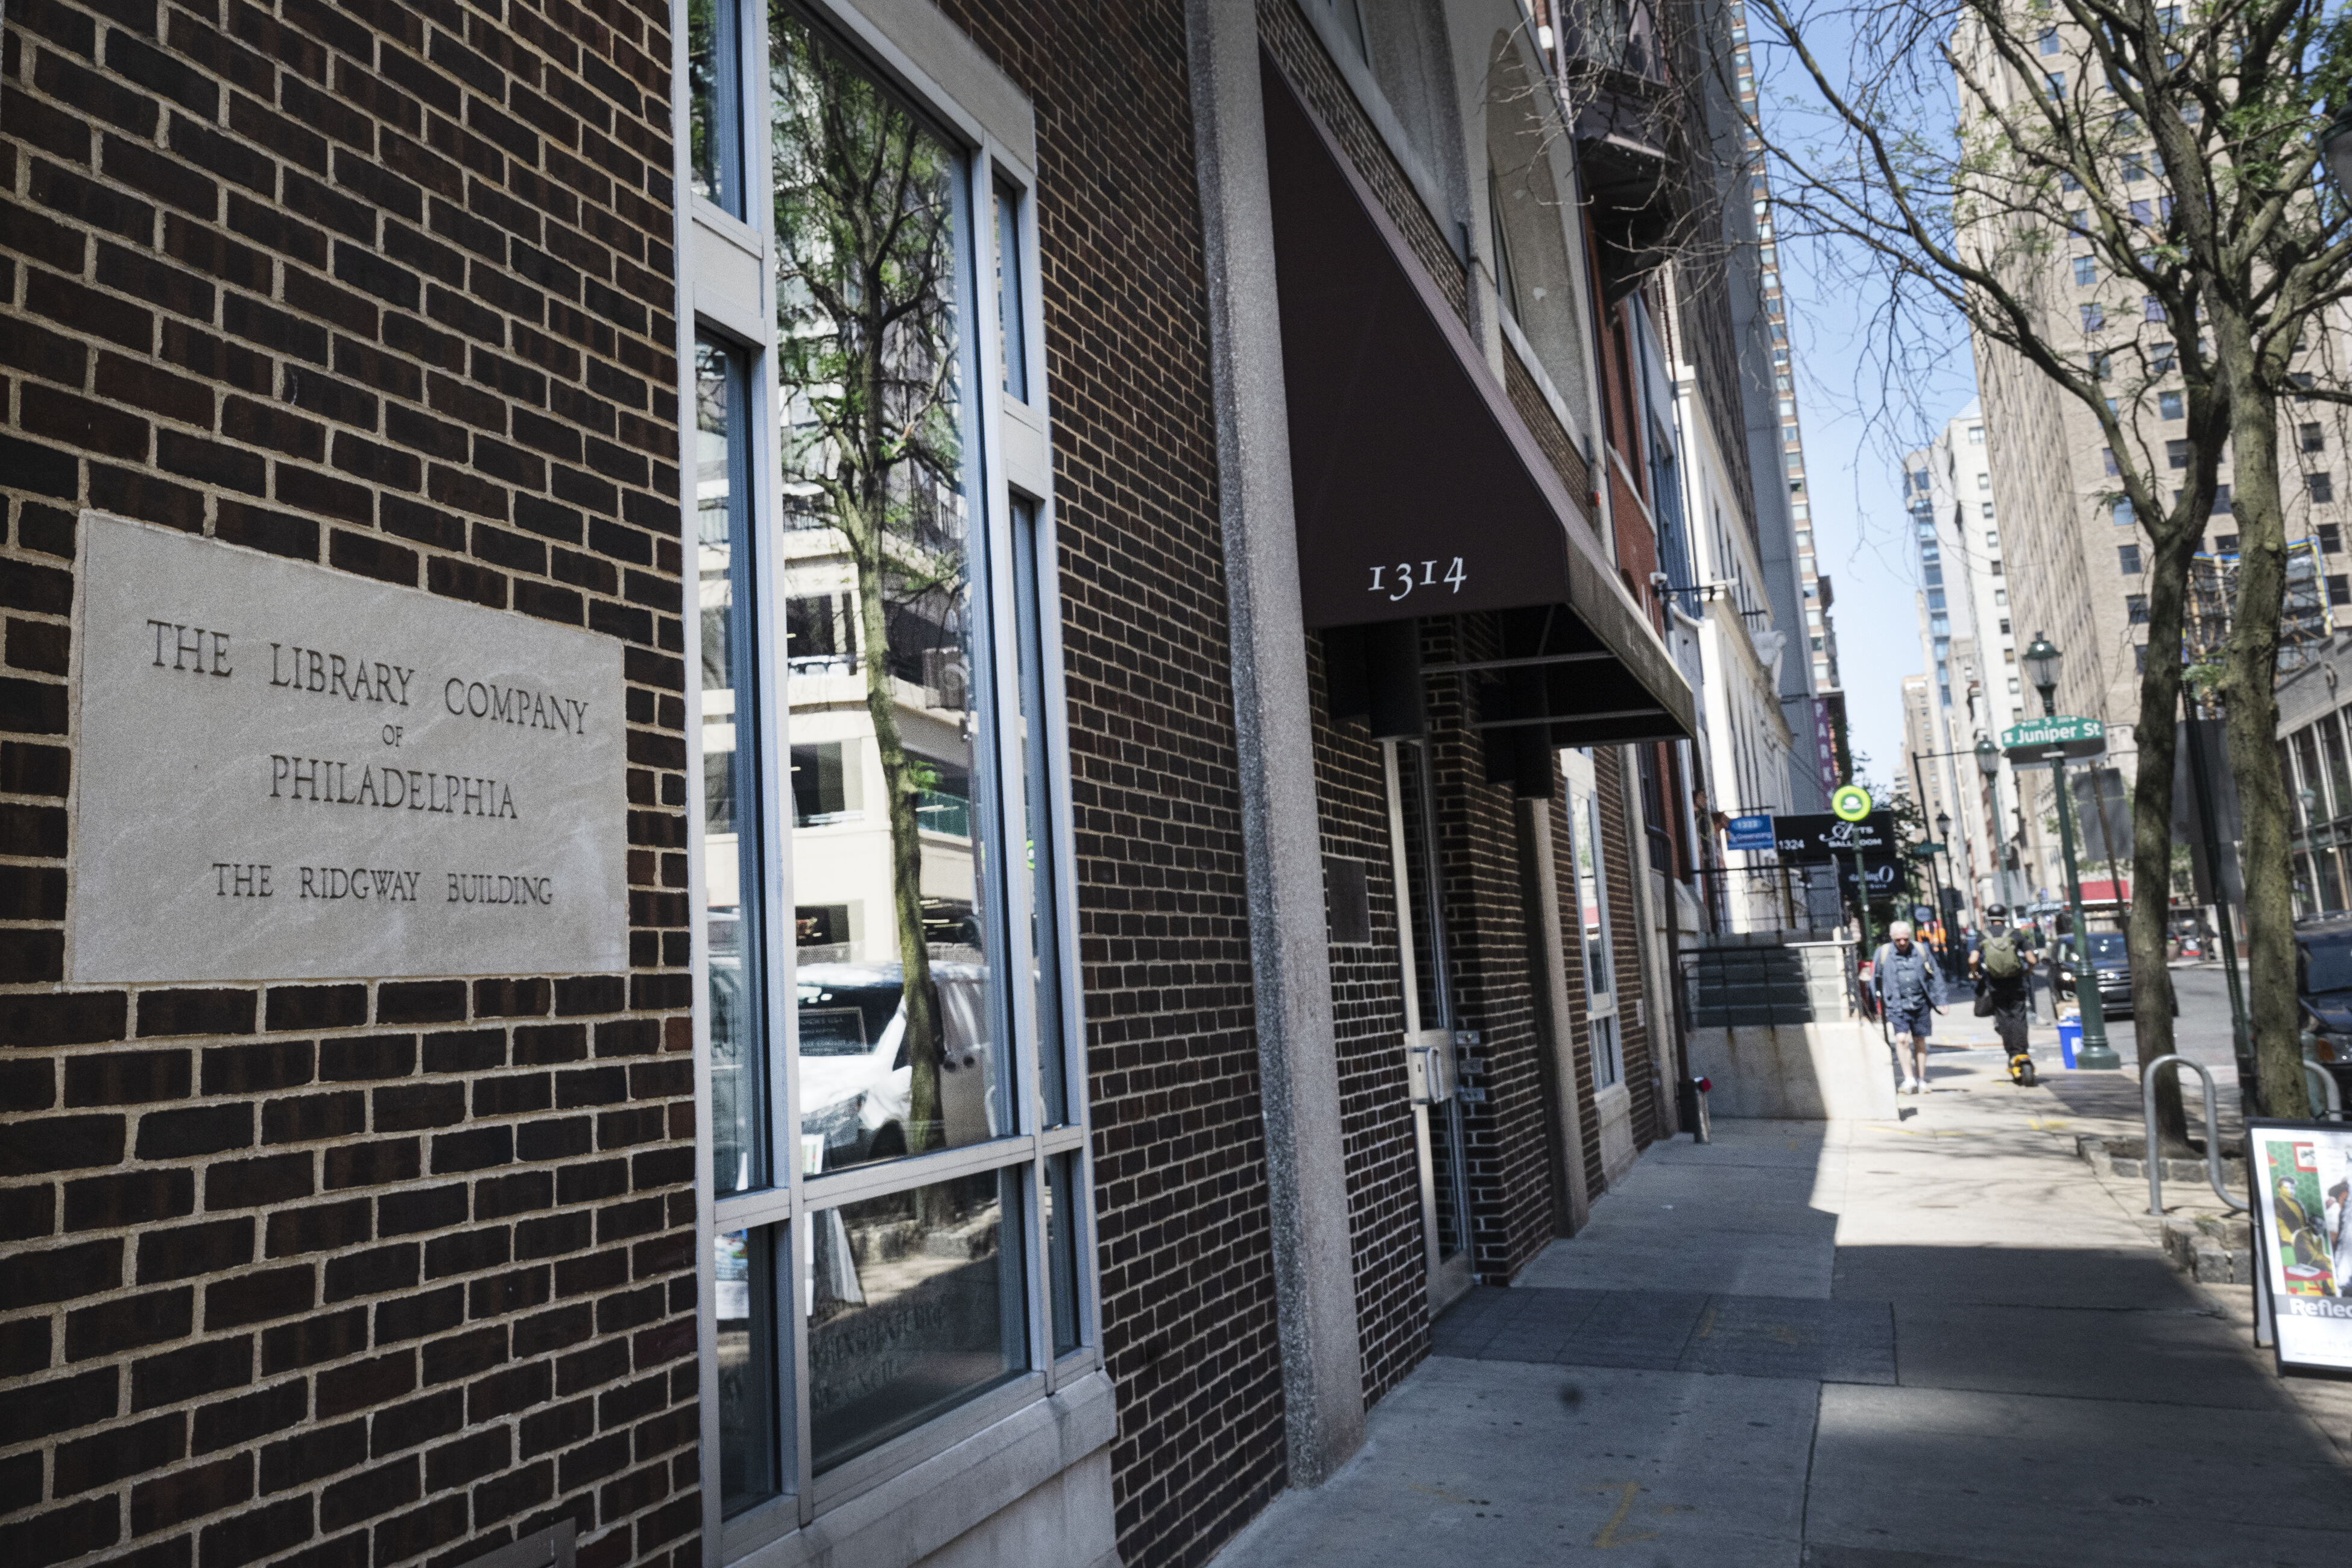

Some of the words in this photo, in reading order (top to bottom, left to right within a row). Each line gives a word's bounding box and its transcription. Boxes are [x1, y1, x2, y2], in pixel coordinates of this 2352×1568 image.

[1368, 556, 1467, 601] 1314
[147, 619, 232, 677] THE
[270, 642, 415, 706] LIBRARY
[444, 677, 589, 735] COMPANY
[2045, 717, 2052, 726] S
[382, 724, 403, 747] OF
[2017, 726, 2076, 744] Juniper
[2082, 722, 2101, 737] St
[270, 754, 518, 819] PHILADELPHIA
[1818, 822, 1874, 840] ATS
[1778, 839, 1805, 850] 1324
[1828, 838, 1882, 848] BALLOOM
[212, 863, 274, 898] THE
[300, 867, 421, 902] RIDGWAY
[446, 873, 553, 905] BUILDING
